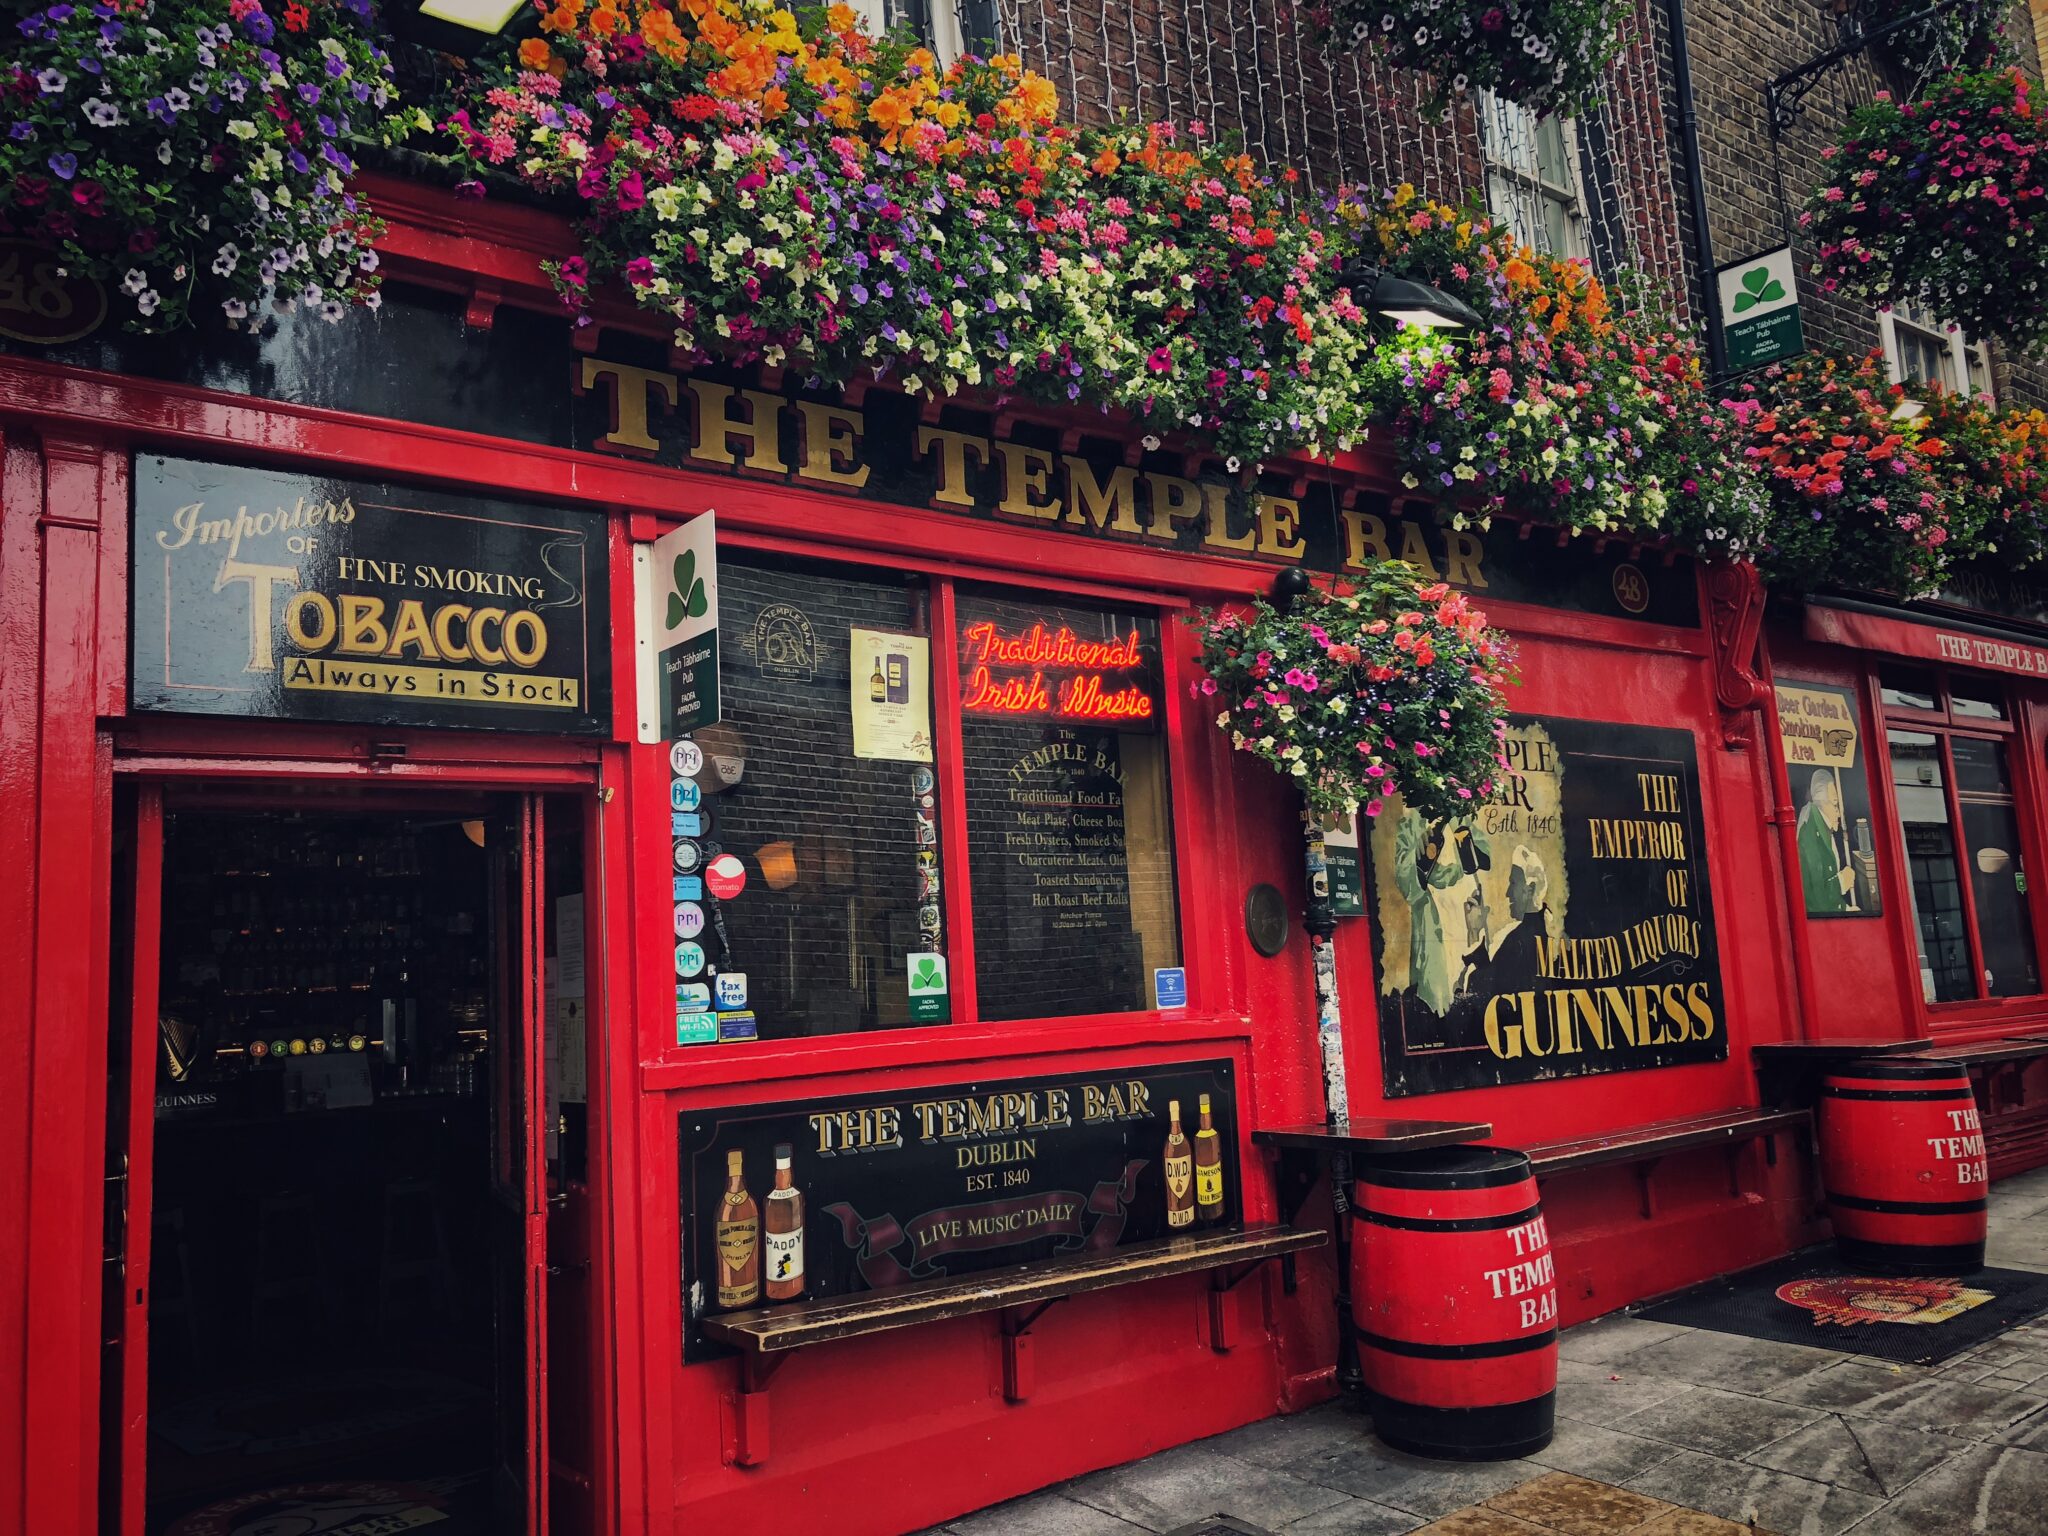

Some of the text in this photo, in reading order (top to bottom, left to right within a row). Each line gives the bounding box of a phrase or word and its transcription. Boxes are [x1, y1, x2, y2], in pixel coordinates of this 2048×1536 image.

[1734, 325, 1755, 337] Teach
[1756, 329, 1771, 339] Pub
[1751, 342, 1781, 357] APPROVED
[582, 357, 1488, 588] THE TEMPLE BAR
[156, 497, 356, 559] Importers
[286, 535, 319, 555] OF
[338, 556, 546, 600] FINE SMOKING
[1618, 571, 1641, 602] 48
[213, 559, 548, 673] TOBACCO
[758, 608, 812, 646] THE TEMPLE BAR
[968, 623, 1141, 666] Traditional
[1936, 633, 1973, 661] THE
[1973, 640, 2034, 672] TEMPLE
[666, 657, 682, 675] Teach
[288, 659, 573, 702] Always in Stock
[682, 669, 694, 685] Pub
[966, 667, 1152, 716] Irish Music
[677, 700, 701, 717] APPROVED
[1802, 695, 1839, 720] Garden
[1059, 729, 1076, 740] The
[1779, 716, 1823, 744] Smoking
[676, 752, 697, 765] PPI
[1792, 740, 1816, 761] Area
[1008, 743, 1088, 784] TEMPLE
[1008, 788, 1073, 804] Traditional
[1077, 791, 1104, 805] Food
[1637, 773, 1681, 813] THE
[1017, 812, 1040, 826] Meat
[1044, 813, 1071, 829] Plate,
[1073, 814, 1104, 828] Cheese
[1484, 808, 1557, 835] Estb. 1840
[1006, 832, 1032, 846] Fresh
[1034, 833, 1072, 849] Oysters,
[1074, 834, 1110, 847] Smoked
[1588, 818, 1687, 861] EMPEROR
[1019, 853, 1074, 866] Charcuterie
[1078, 853, 1107, 868] Meats,
[711, 883, 740, 891] zomato
[1033, 873, 1124, 886] Toasted Sandwiches
[1666, 869, 1689, 908] OF
[1032, 894, 1051, 906] Hot
[1053, 894, 1079, 906] Roast
[1082, 893, 1103, 906] Beef
[677, 914, 698, 925] PPI
[1535, 913, 1702, 980] MALTED LIQUORS
[679, 954, 699, 965] PPI
[721, 979, 741, 992] tax
[721, 992, 745, 1003] free
[680, 1023, 700, 1031] WI-FI
[1484, 982, 1715, 1060] GUINNESS
[154, 1093, 217, 1108] GUINNESS
[808, 1080, 1155, 1159] THE TEMPLE BAR
[1946, 1108, 1981, 1131] THE
[957, 1139, 1037, 1169] DUBLIN
[1167, 1160, 1190, 1178] D.W.D.
[1197, 1167, 1221, 1177] JAMESON
[967, 1169, 1030, 1192] EST. 1840
[773, 1190, 795, 1198] PADDY
[919, 1204, 1076, 1247] LIVE MUSIC DAILY
[1172, 1211, 1191, 1224] D.W.D.
[766, 1233, 803, 1251] PADDY
[1507, 1215, 1548, 1257] THE
[1519, 1288, 1558, 1328] BAR
